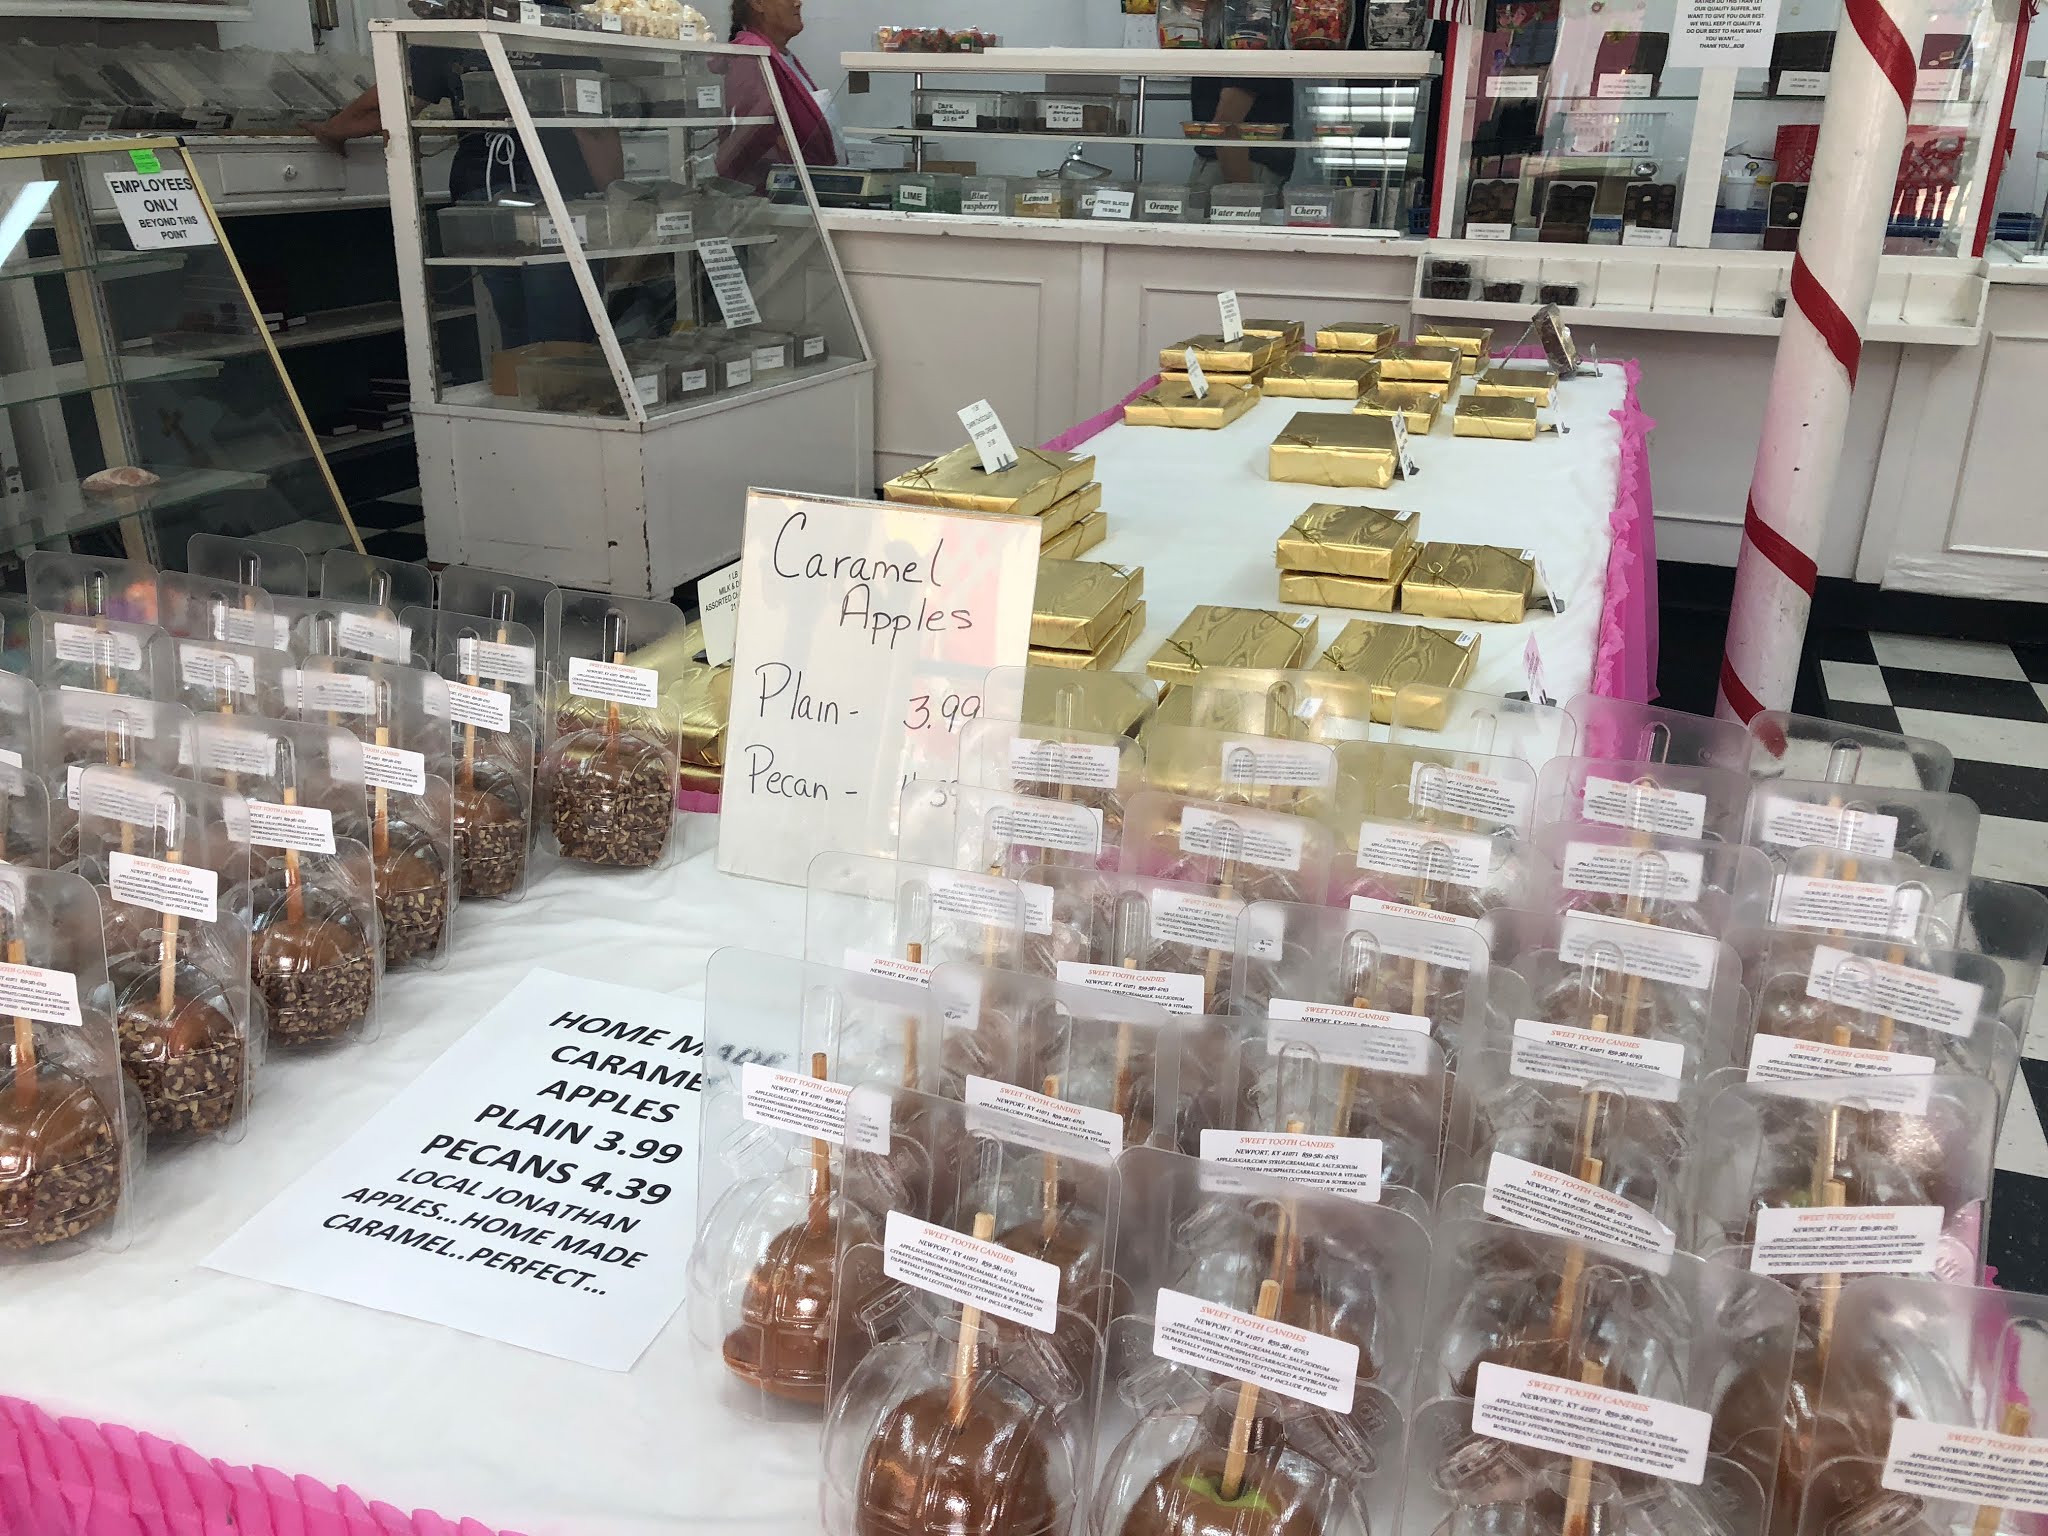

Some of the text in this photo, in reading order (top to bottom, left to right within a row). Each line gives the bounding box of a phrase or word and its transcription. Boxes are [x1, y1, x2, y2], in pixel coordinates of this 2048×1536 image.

[110, 178, 193, 194] EMPLOYEES
[902, 191, 923, 201] LIME
[970, 191, 990, 200] Blue
[143, 198, 179, 213] ONLY
[963, 202, 999, 212] raspberry
[1023, 193, 1049, 202] Lemon
[1149, 202, 1180, 212] Orange
[138, 216, 198, 228] BEYOND THIS
[1209, 207, 1261, 217] Water melon
[1294, 206, 1323, 217] Cherry
[160, 230, 188, 240] POINT
[773, 511, 944, 587] Caramel
[732, 570, 739, 580] LB
[718, 583, 731, 595] MILK
[731, 582, 735, 590] &
[705, 594, 732, 612] ASSORTED
[839, 583, 973, 650] Apples
[903, 694, 982, 733] 3.99
[1305, 1006, 1390, 1021] SWEET TOOTH CANDIES
[549, 1011, 671, 1048] HOME
[1551, 1029, 1640, 1049] SWEET TOOTH CANDIES
[550, 1045, 703, 1094] CARAME
[536, 1079, 681, 1124] APPLES
[1000, 1087, 1081, 1115] SWEET TOOTH CANDIES
[474, 1103, 684, 1165] PLAIN 3.99
[1299, 1140, 1335, 1148] CANDIES
[420, 1133, 672, 1206] PECANS 4.39
[1525, 1179, 1560, 1198] NEWPORT,
[1562, 1191, 1573, 1200] KY
[1531, 1169, 1630, 1209] SWEET TOOTH CANDIES
[396, 1167, 642, 1234] LOCAL JONATHAN
[550, 1233, 649, 1270] MADE
[918, 1238, 951, 1254] NEWPORT,
[952, 1250, 961, 1258] KY
[962, 1254, 977, 1263] 41071
[923, 1227, 1015, 1264] SWEET TOOTH CANDIES
[1194, 1316, 1232, 1333] NEWPORT,
[1234, 1329, 1245, 1337] KY
[1246, 1333, 1263, 1342] 41071
[1199, 1305, 1306, 1343] SWEET TOOTH CANDIES
[1201, 1345, 1250, 1365] HYDROGENATED
[1250, 1361, 1291, 1378] COTTONSEED
[1297, 1374, 1327, 1388] SOYBEAN
[1327, 1383, 1338, 1391] OIL
[1205, 1355, 1233, 1369] LECITHIN
[1234, 1364, 1256, 1376] ADDED
[1259, 1372, 1273, 1381] MAY
[1274, 1377, 1301, 1390] INCLUDE
[1302, 1385, 1327, 1398] PECANS
[1313, 1371, 1340, 1383] VITAMIN
[1527, 1378, 1649, 1412] SWEET TOOTH CANDIES
[1566, 1401, 1578, 1409] KY
